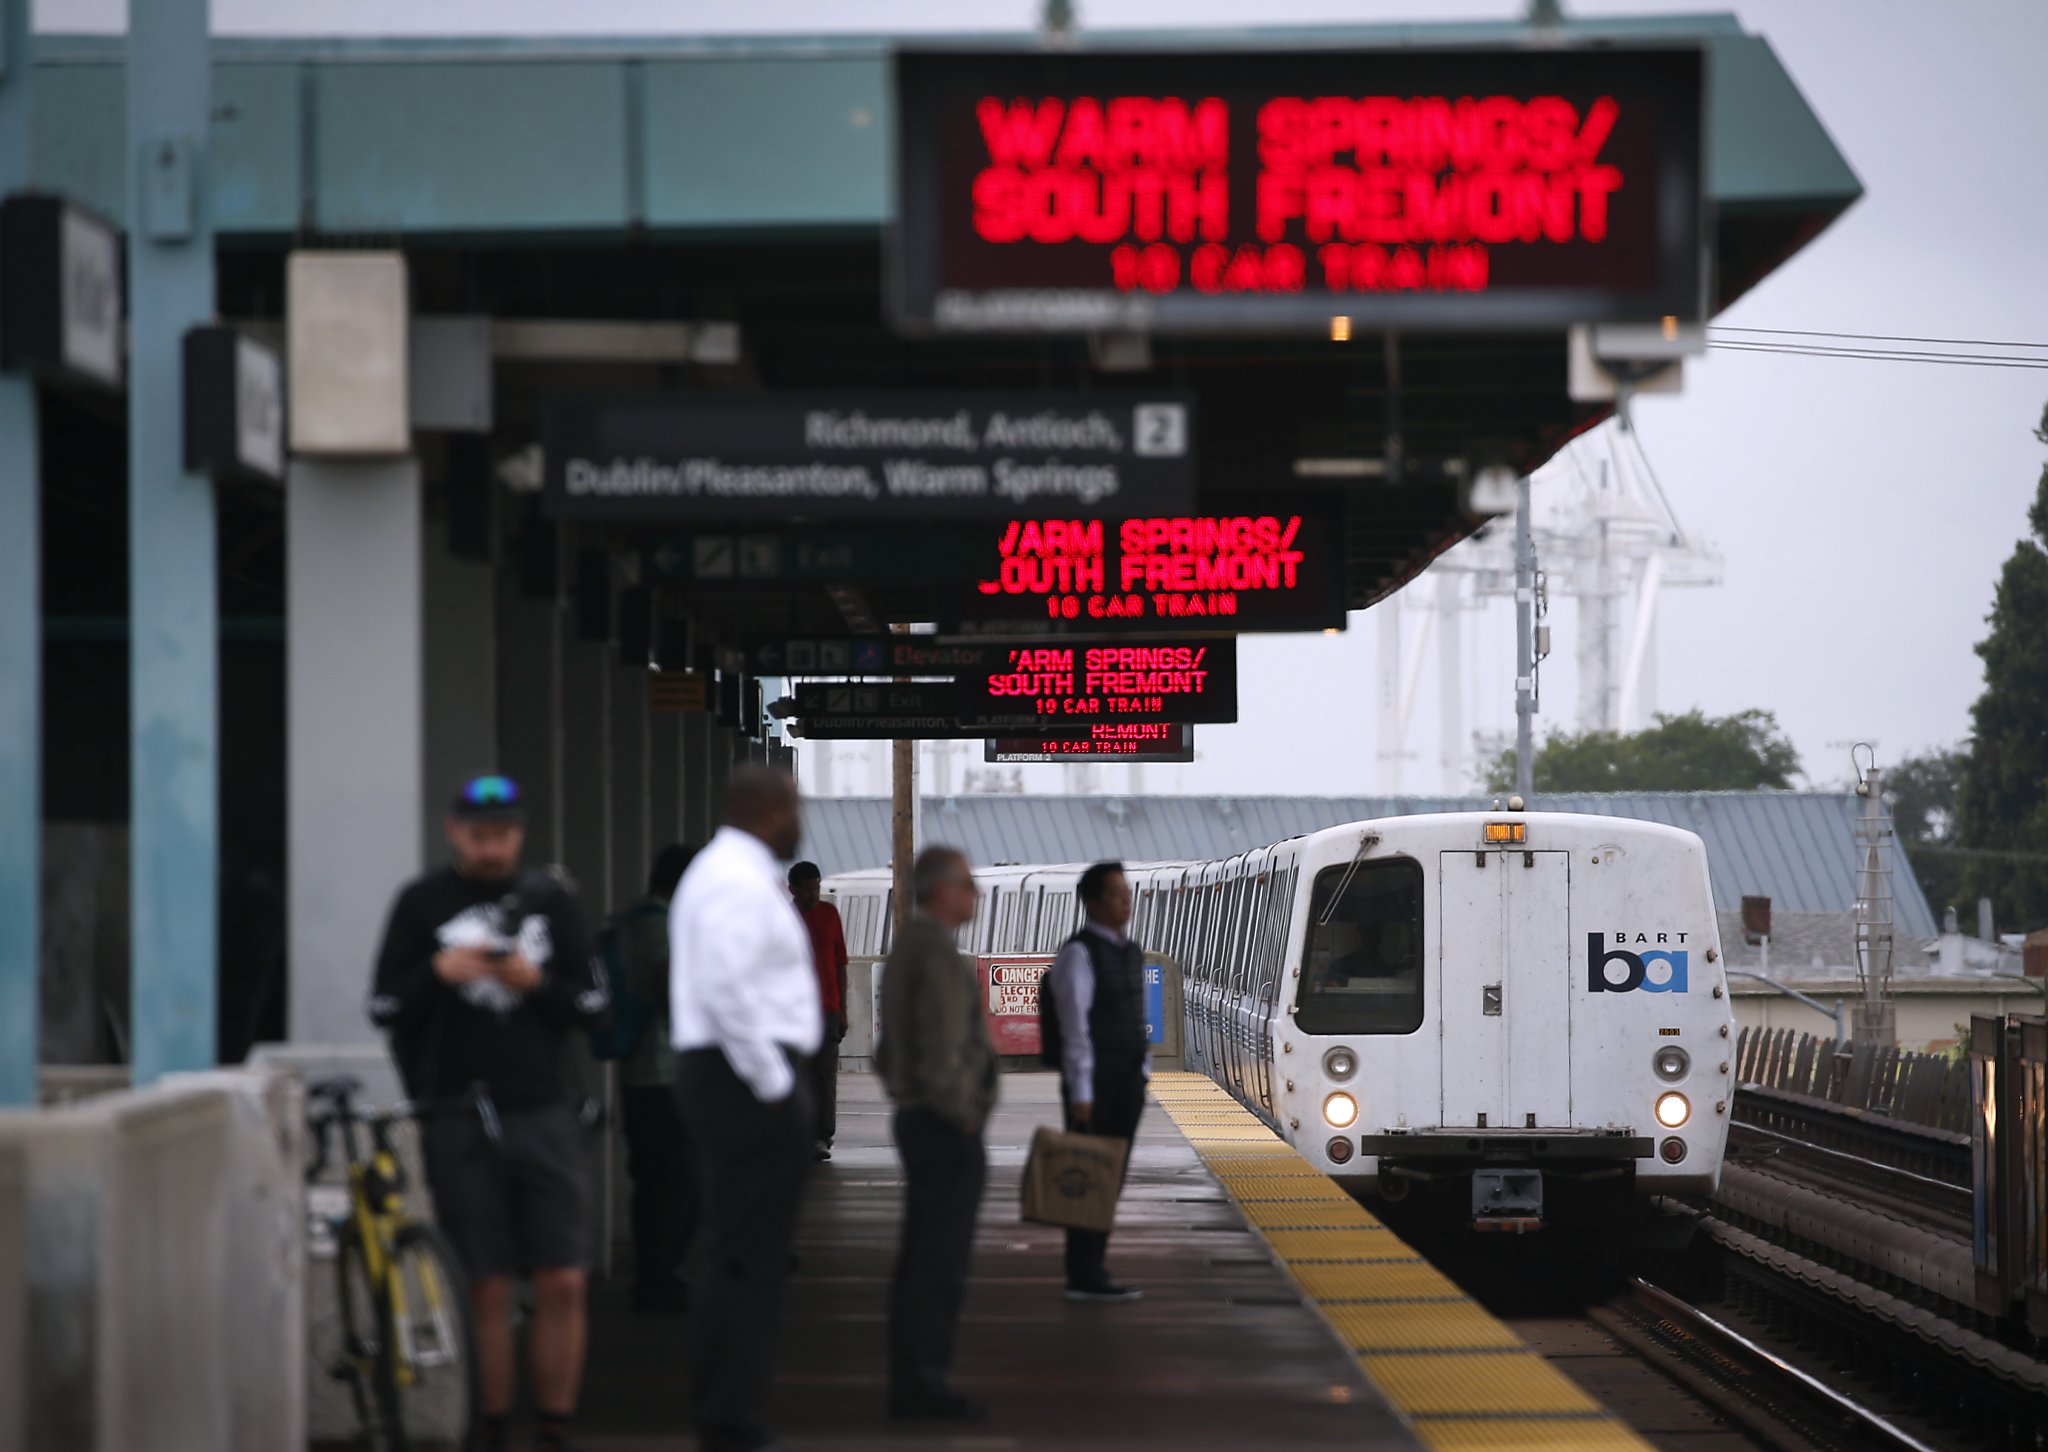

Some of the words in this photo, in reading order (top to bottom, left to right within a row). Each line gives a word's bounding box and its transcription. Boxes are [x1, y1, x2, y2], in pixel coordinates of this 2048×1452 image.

[976, 96, 1229, 168] WARM
[1257, 96, 1619, 169] SPRINGS/
[972, 167, 1229, 243] SOUTH
[1256, 165, 1623, 243] FREMONT
[1110, 244, 1181, 292] 10
[1190, 243, 1306, 292] CAR
[1318, 243, 1489, 292] TRAIN
[806, 412, 978, 452] Richmond,
[985, 412, 1123, 451] Antioch,
[566, 458, 878, 499] Dublin/Pleasanton,
[883, 461, 987, 496] Warm
[994, 459, 1119, 504] Springs
[1120, 515, 1303, 555] SPRINGS/
[978, 554, 1104, 594] OUTH
[1120, 551, 1304, 593] FREMONT
[1047, 595, 1080, 619] 10
[1087, 594, 1144, 618] CAR
[1152, 593, 1237, 617] TRAIN
[894, 645, 983, 666] Elevator
[1009, 649, 1074, 672] ARM
[1085, 647, 1206, 671] SPRINGS/
[988, 673, 1074, 696] SOUTH
[1085, 671, 1208, 694] FREMONT
[889, 692, 922, 708] Exit
[1036, 698, 1058, 714] 10
[1063, 698, 1100, 714] CAR
[1107, 697, 1163, 713] TRAIN
[997, 753, 1043, 762] PLATFORM
[1045, 753, 1052, 761] 2
[1042, 741, 1058, 753] 10
[1062, 741, 1090, 753] CAR
[1096, 741, 1138, 753] TRAIN
[1616, 932, 1689, 944] BART
[1009, 1005, 1024, 1014] NOT
